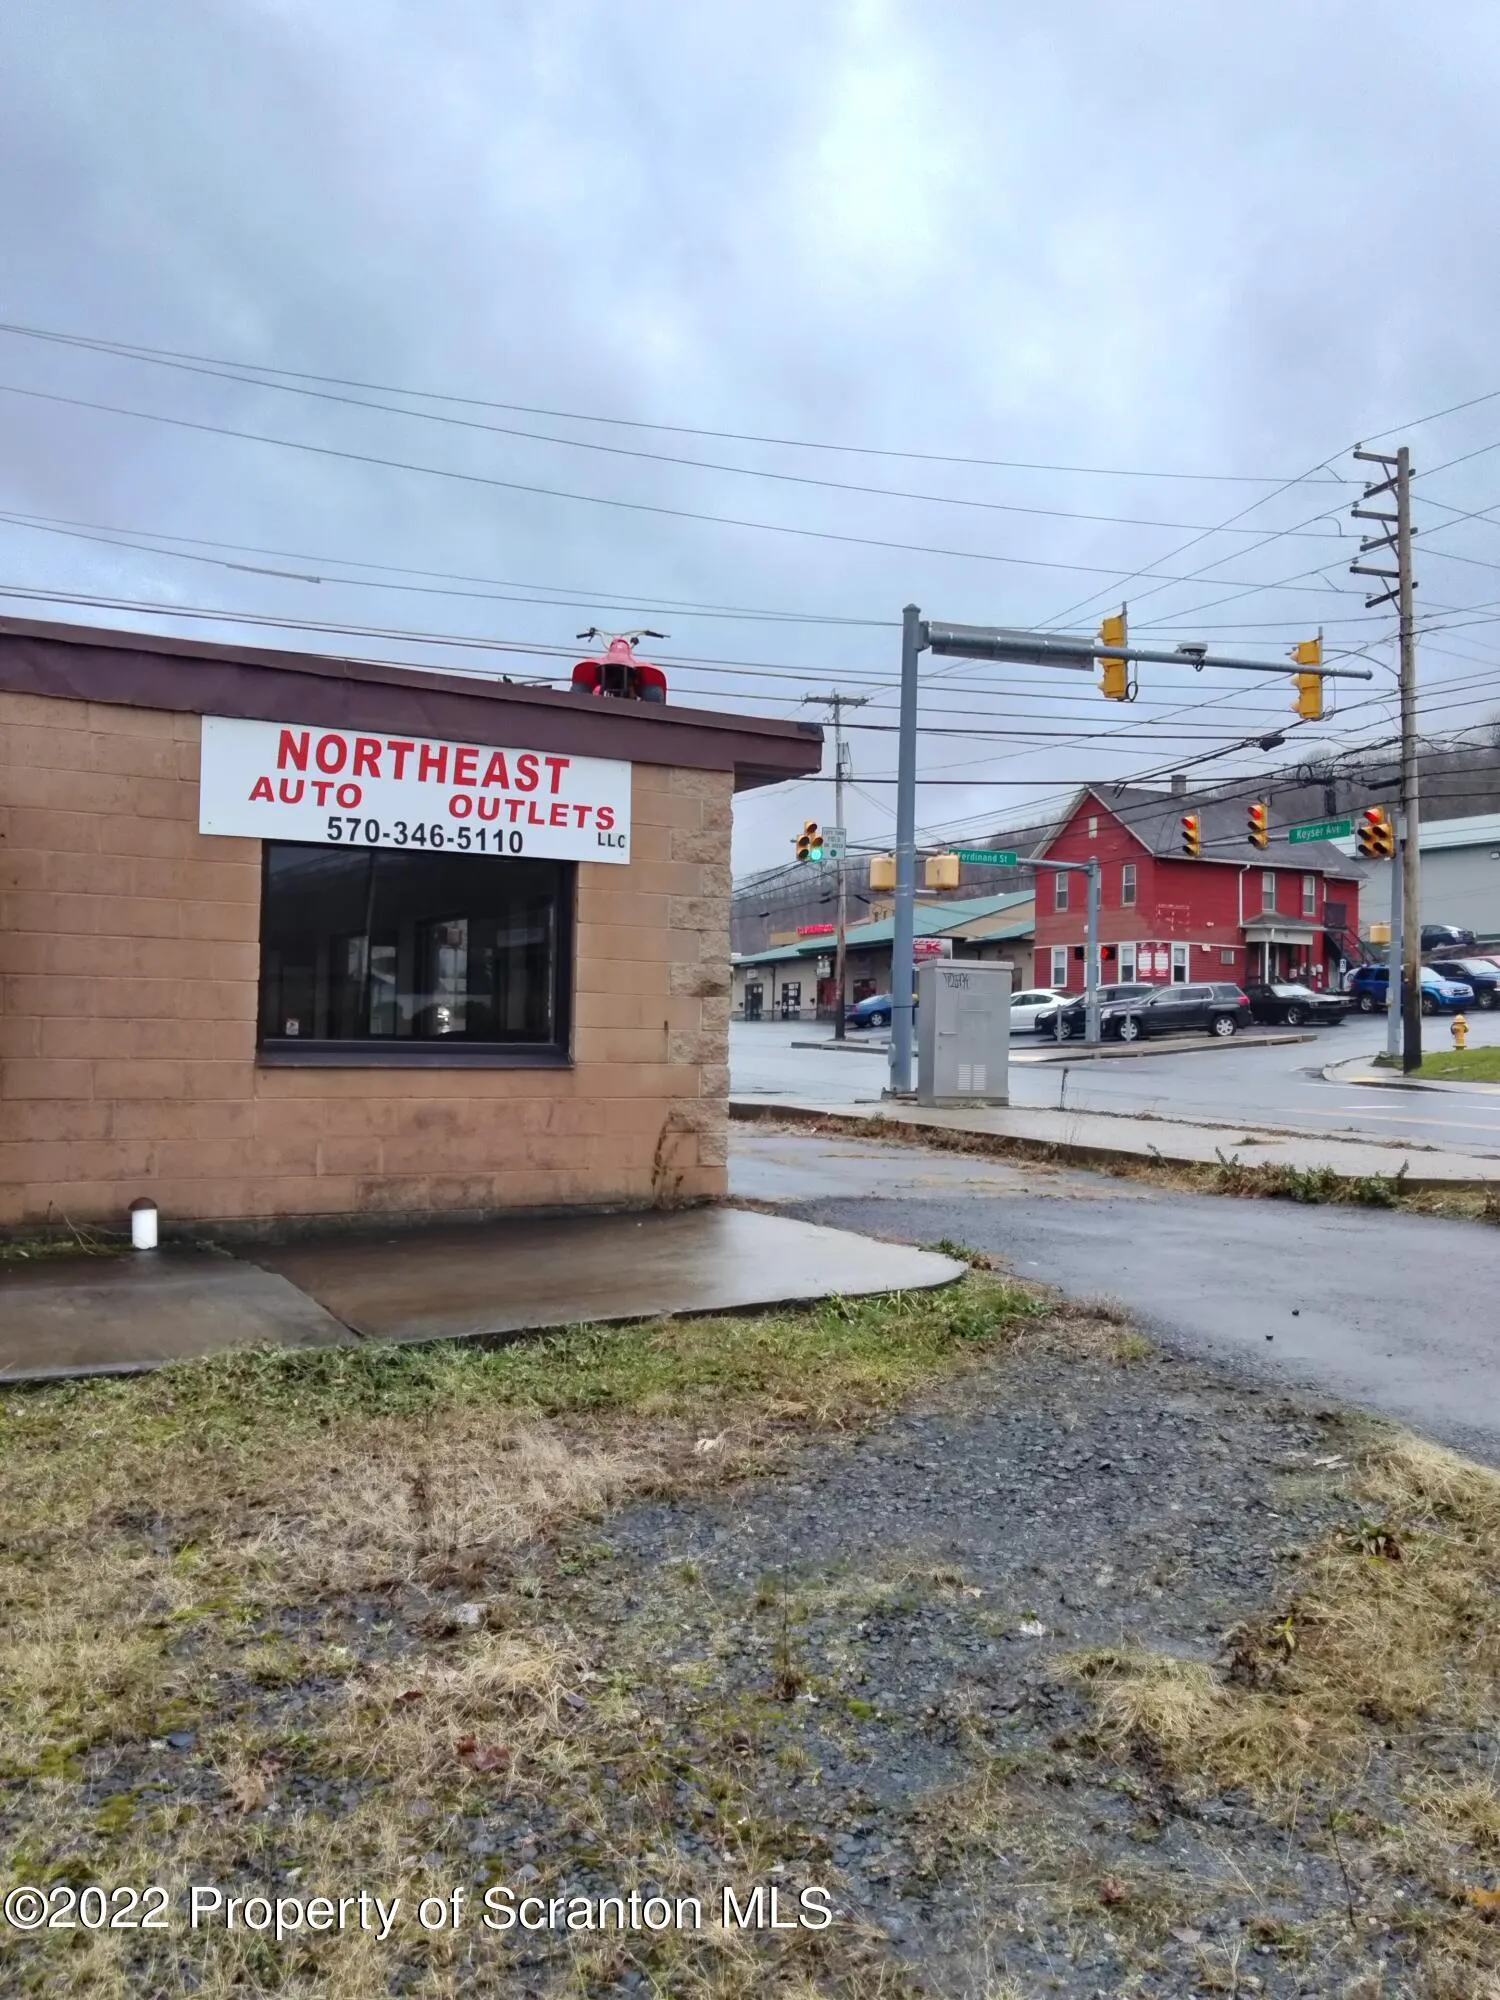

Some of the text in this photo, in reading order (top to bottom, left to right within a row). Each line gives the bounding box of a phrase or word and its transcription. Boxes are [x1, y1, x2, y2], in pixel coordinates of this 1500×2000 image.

[276, 729, 571, 794] NORTHEAST
[248, 776, 616, 831] AUTO OUTLETS
[326, 816, 524, 854] 570-346-5110
[597, 831, 626, 849] LLC
[1296, 827, 1324, 840] Keyser
[960, 852, 1008, 863] erdinand St
